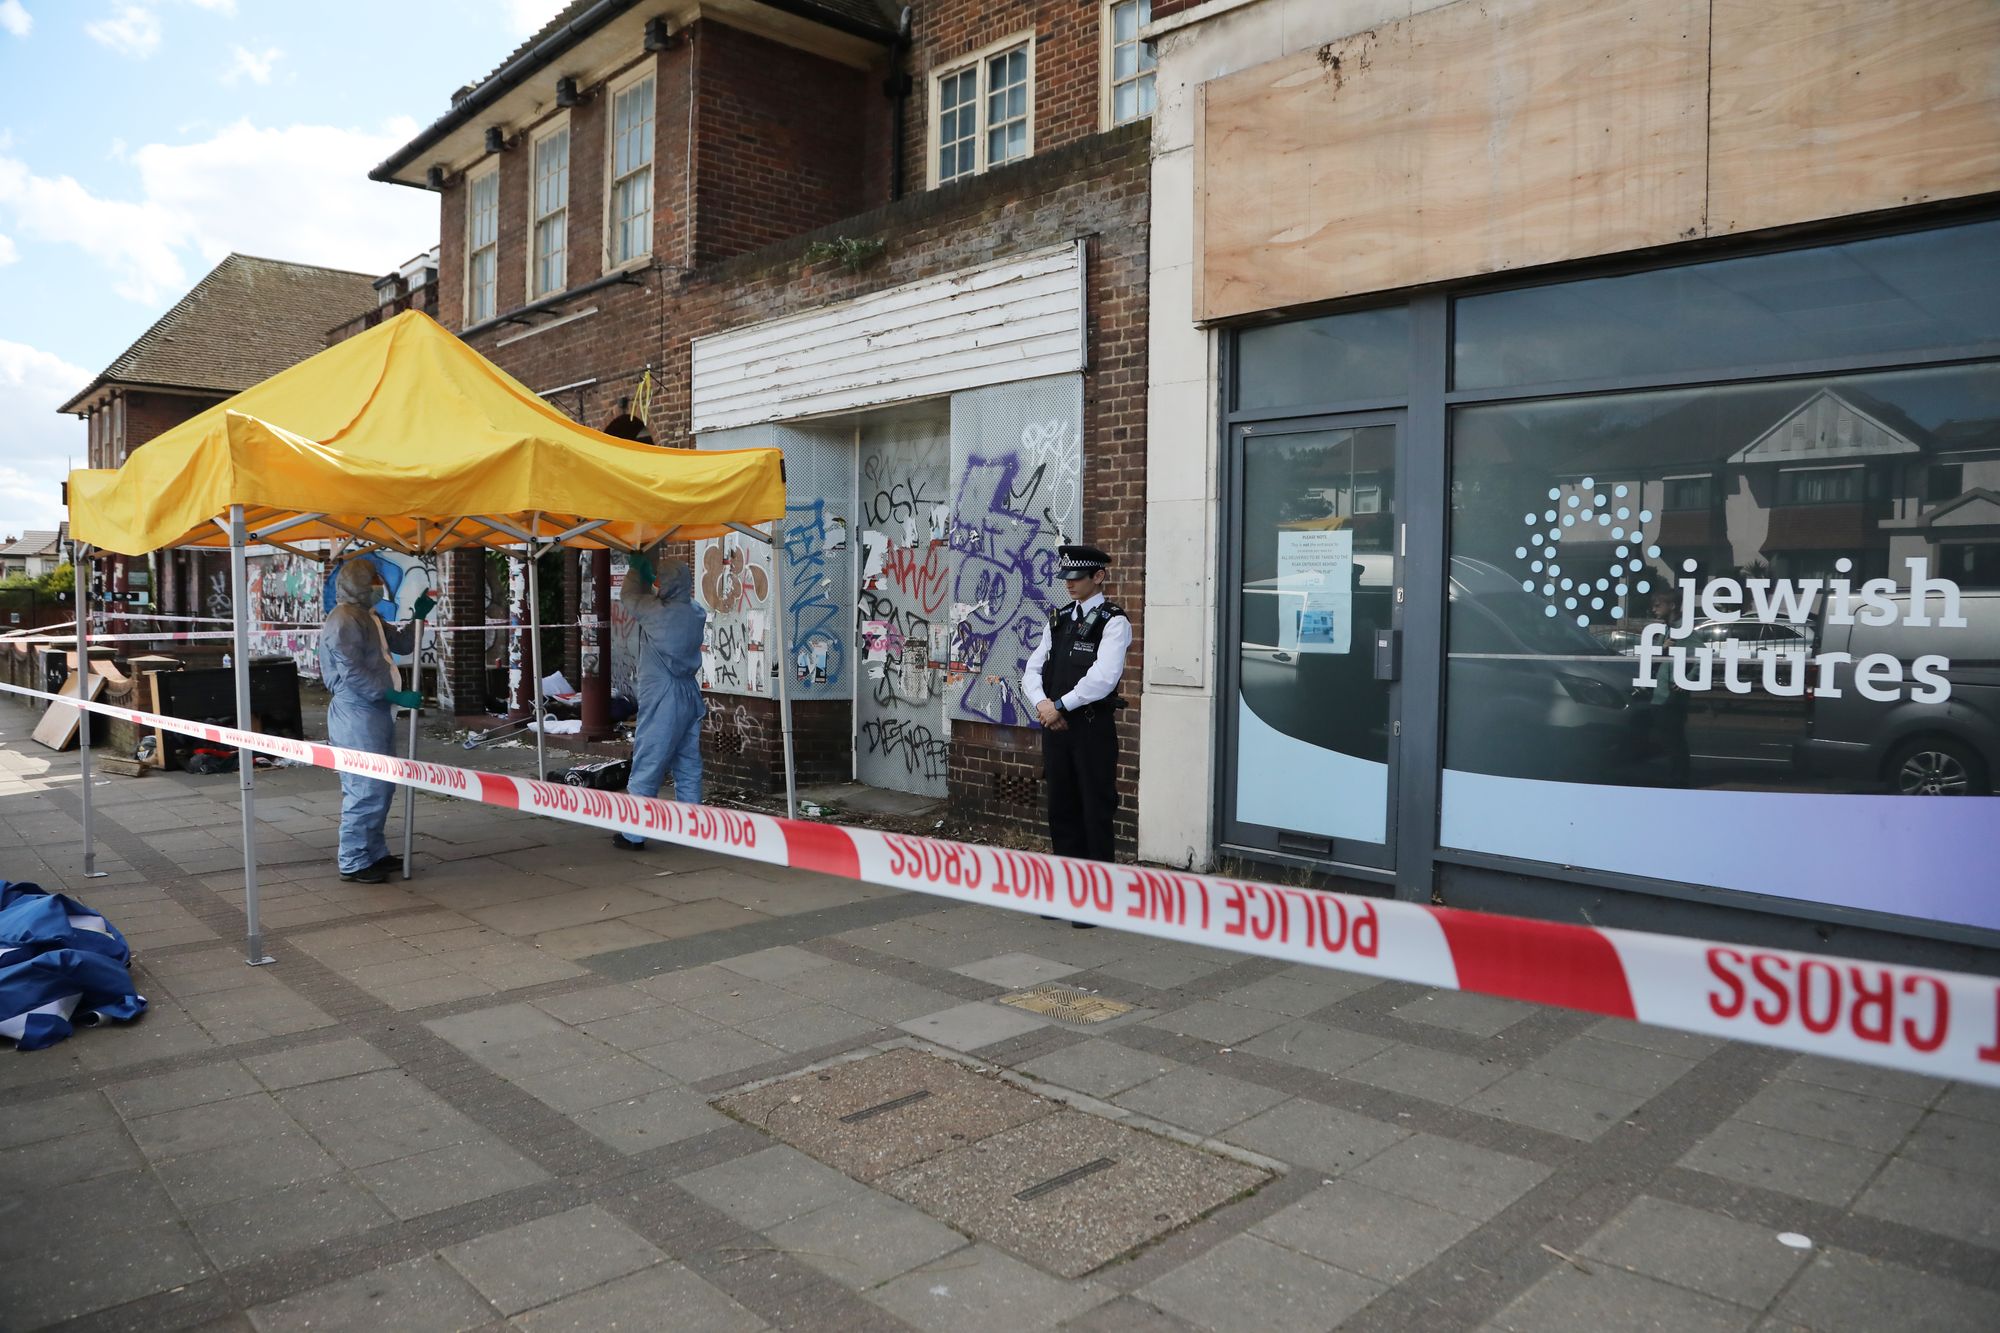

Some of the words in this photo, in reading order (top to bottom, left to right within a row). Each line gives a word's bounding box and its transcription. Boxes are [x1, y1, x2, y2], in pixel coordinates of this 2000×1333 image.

[1669, 557, 1967, 640] jewish
[1632, 623, 1951, 704] futures
[428, 764, 467, 790] POLICE
[583, 788, 612, 819] NOT
[615, 793, 639, 825] DO
[644, 797, 683, 834] LINE
[686, 805, 756, 848] POLICE
[881, 832, 982, 889] CROSS
[992, 850, 1054, 902] NOT
[1060, 858, 1113, 912] DO
[1118, 867, 1209, 930] LINE
[1217, 881, 1379, 959] POLICE
[1705, 946, 1950, 1055] CROSS
